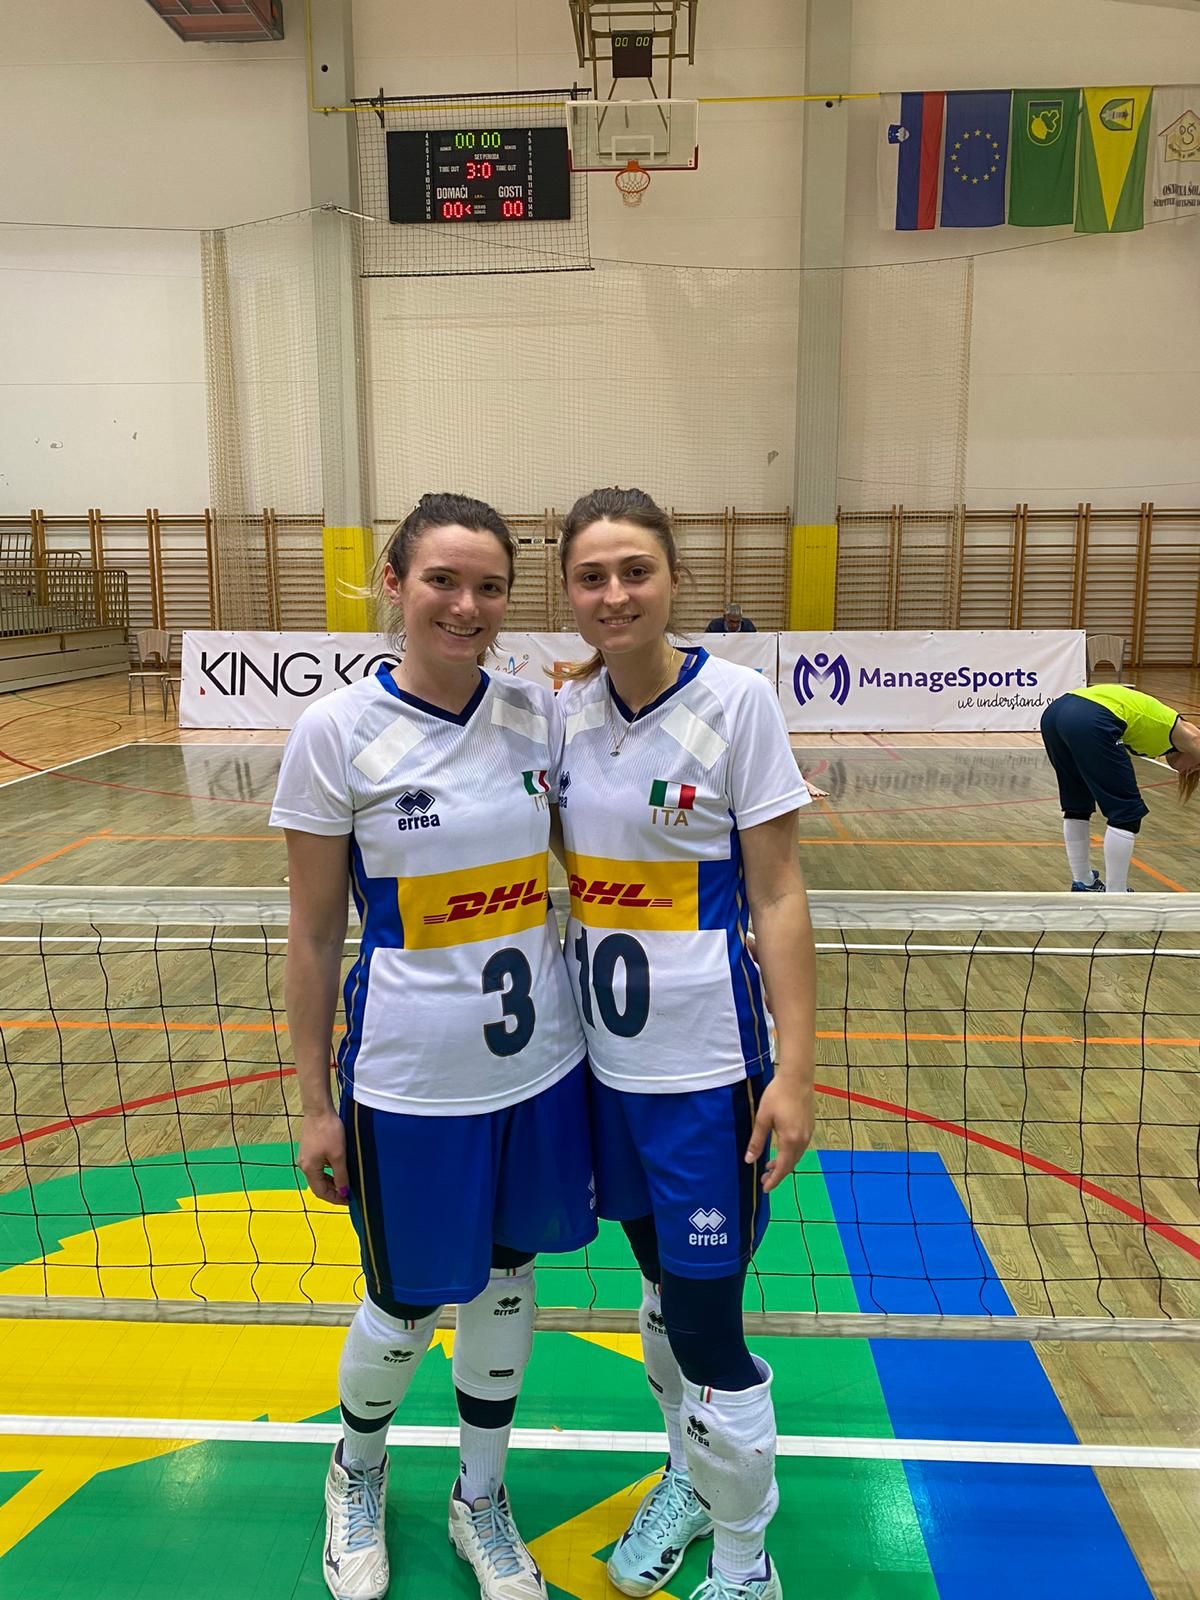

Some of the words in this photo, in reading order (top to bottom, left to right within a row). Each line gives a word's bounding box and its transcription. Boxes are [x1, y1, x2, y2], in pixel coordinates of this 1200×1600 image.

[614, 36, 628, 47] 00
[636, 36, 650, 46] 00
[456, 132, 474, 148] 00
[481, 132, 501, 148] 00
[498, 186, 522, 198] GOSTI
[443, 202, 463, 218] 00
[503, 201, 523, 217] 00
[201, 652, 322, 698] KING
[334, 652, 402, 684] KO
[859, 666, 1038, 692] ManageSports
[957, 697, 974, 709] we
[976, 692, 1045, 710] understand
[398, 814, 440, 830] errea
[652, 808, 689, 826] ITA
[570, 873, 652, 908] DHL
[446, 878, 544, 922] DHL
[575, 926, 650, 1038] 10
[482, 947, 536, 1057] 3
[688, 1230, 728, 1246] errea
[494, 1306, 520, 1316] errea
[687, 1426, 710, 1448] errea
